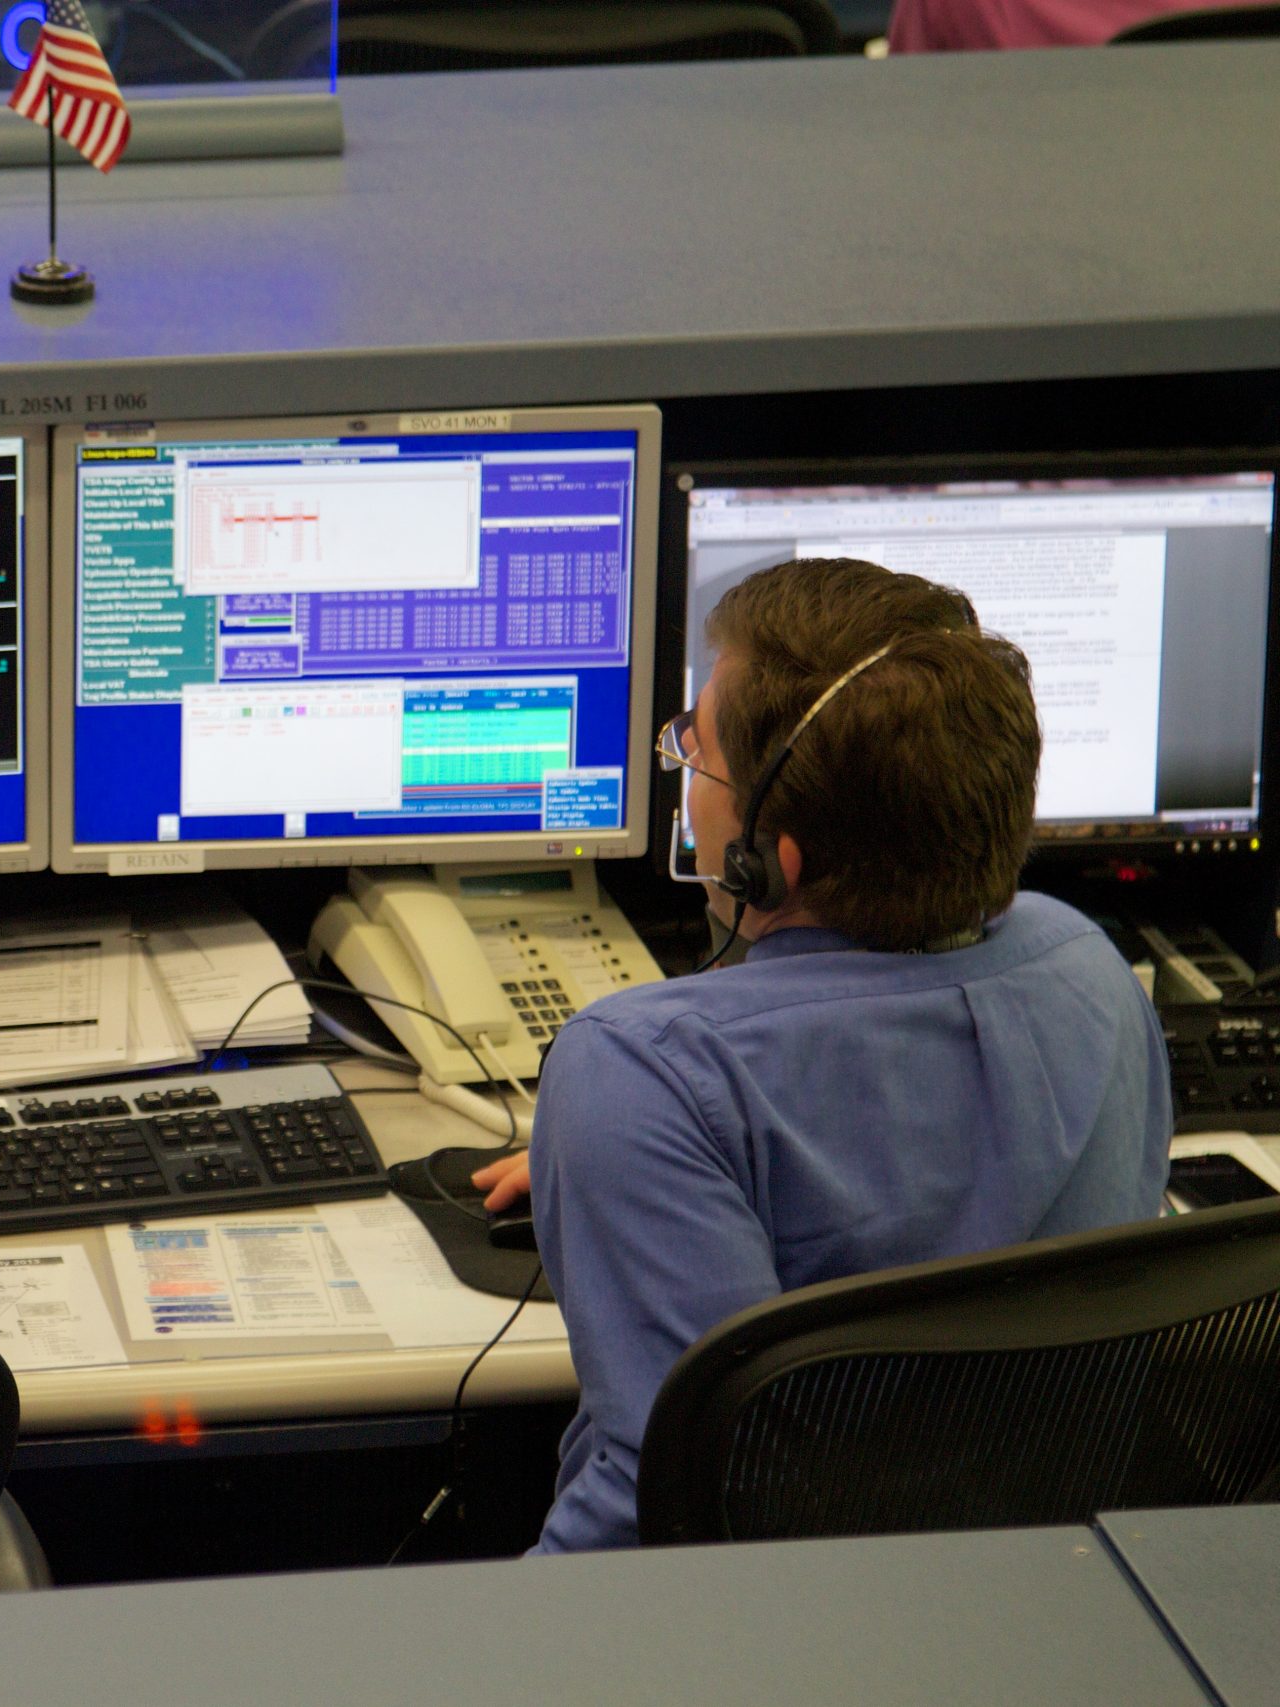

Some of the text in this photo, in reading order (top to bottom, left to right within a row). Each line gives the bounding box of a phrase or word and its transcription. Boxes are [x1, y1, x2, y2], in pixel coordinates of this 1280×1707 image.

[21, 396, 72, 415] 205M
[114, 393, 147, 411] 006
[411, 418, 442, 431] SVO
[444, 417, 461, 429] 41
[465, 415, 497, 429] MON
[126, 853, 190, 868] RETAIN
